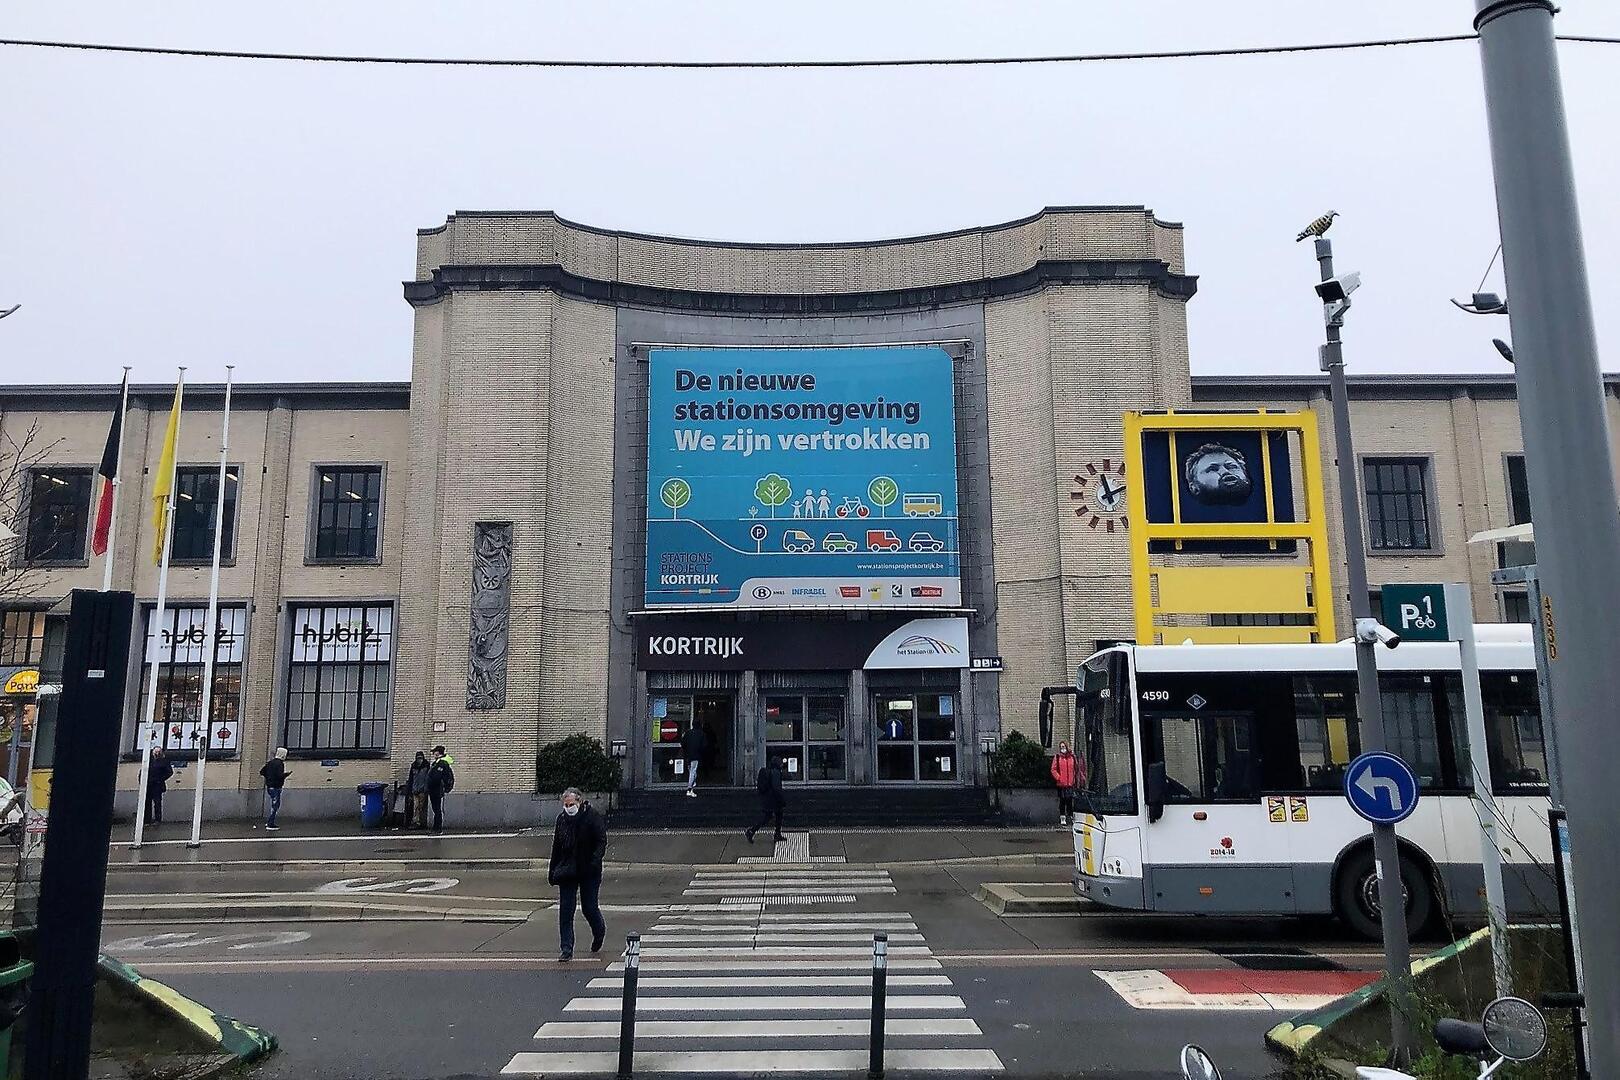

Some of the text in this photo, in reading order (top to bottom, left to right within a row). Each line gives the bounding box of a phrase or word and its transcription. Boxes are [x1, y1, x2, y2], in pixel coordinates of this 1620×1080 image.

[674, 369, 816, 391] De nieuwe
[674, 397, 920, 425] stationsomgeving
[674, 427, 930, 457] We zijn vertrokken
[660, 552, 713, 564] STATIONS
[660, 564, 709, 574] PROJECT
[857, 562, 944, 570] www.stationsprojectkortrijk.be
[660, 574, 719, 585] KORTRIJK
[791, 587, 827, 596] INFRABEL
[1423, 595, 1433, 613] 1
[649, 637, 744, 658] KORTRIJK
[1142, 691, 1169, 700] 4590
